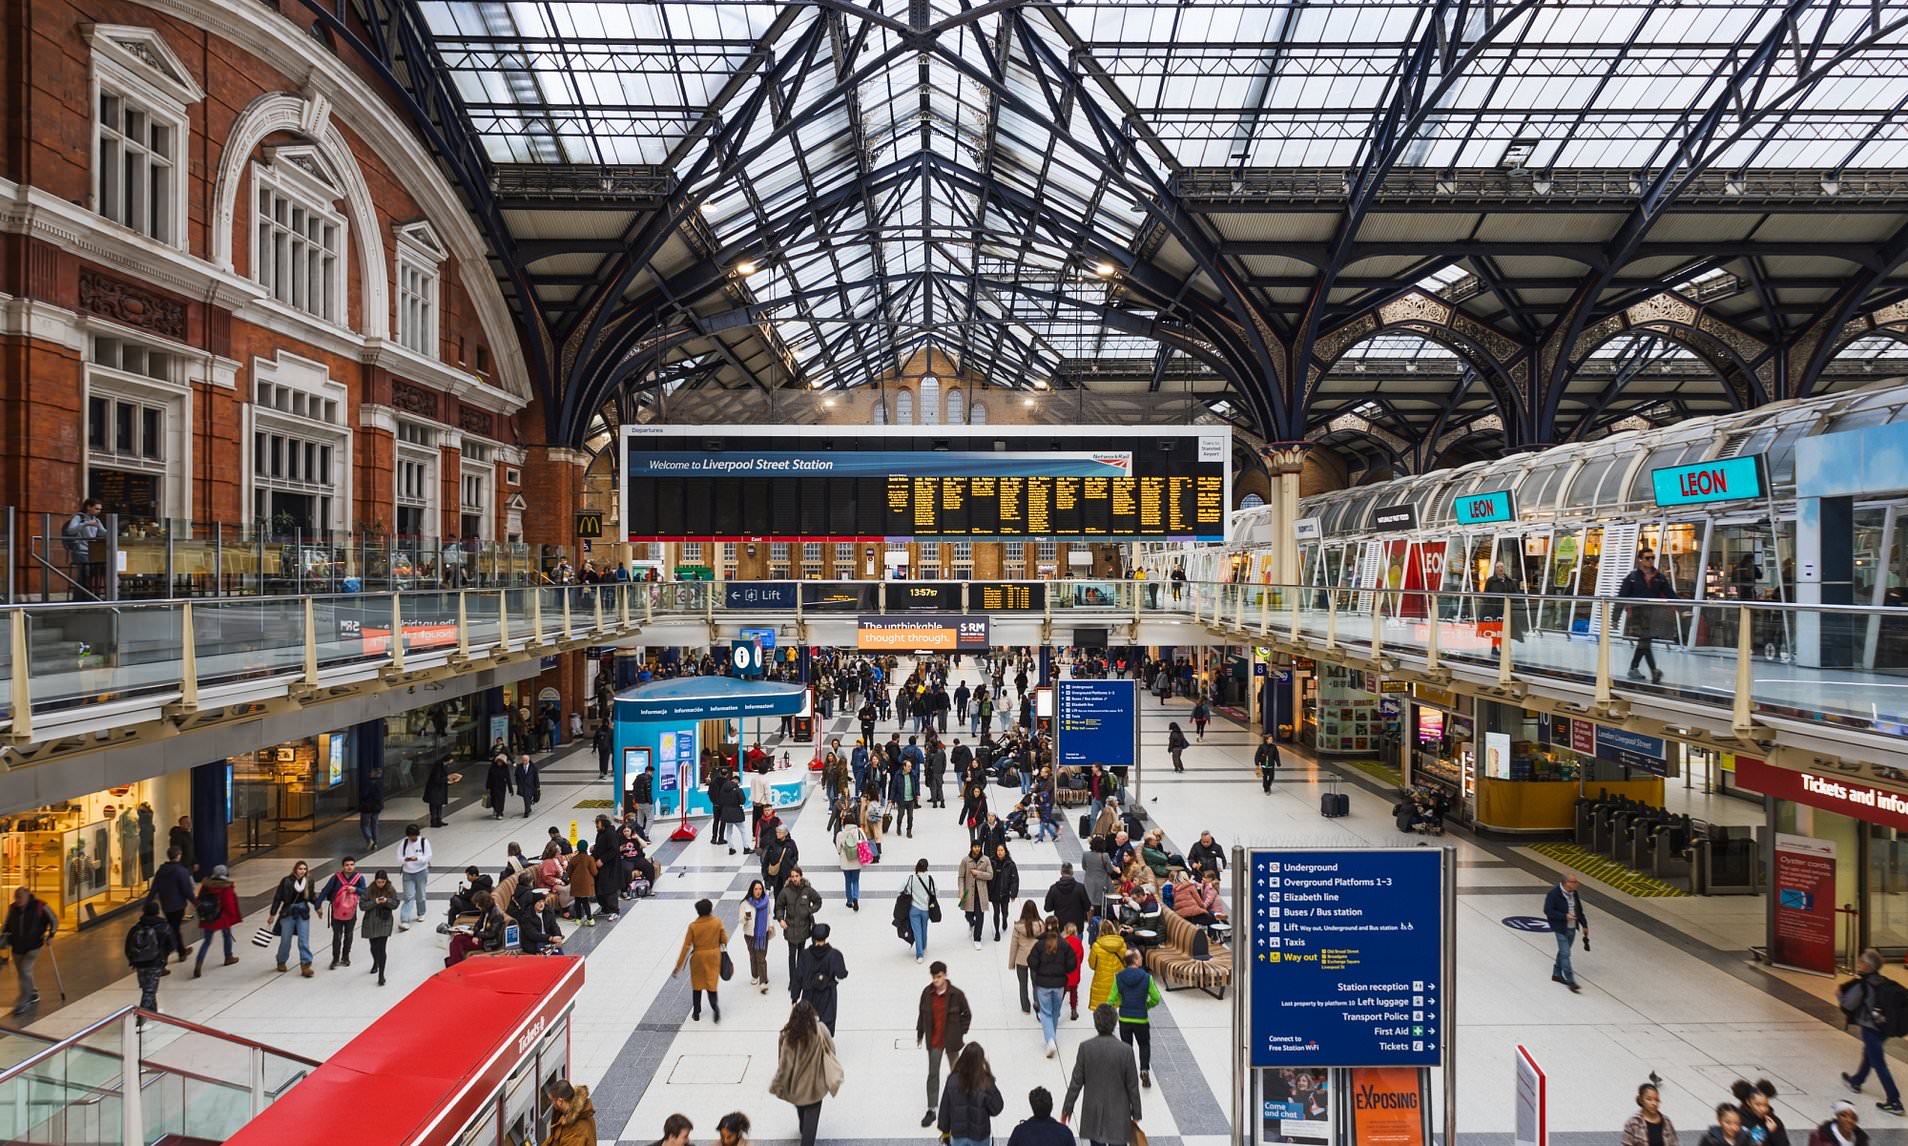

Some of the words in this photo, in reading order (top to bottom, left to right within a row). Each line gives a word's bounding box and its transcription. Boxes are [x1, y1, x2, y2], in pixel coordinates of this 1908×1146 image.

[649, 460, 690, 470] Welcome
[692, 461, 701, 470] to
[702, 459, 754, 472] Liverpool
[755, 459, 789, 471] Street
[792, 459, 833, 471] Station
[1679, 468, 1728, 497] LEON
[1469, 499, 1494, 518] LEON
[762, 589, 781, 600] Lift
[865, 632, 905, 645] thought
[1257, 665, 1263, 674] 8
[1539, 711, 1549, 726] 10
[1801, 773, 1847, 800] Tickets
[1848, 788, 1875, 806] and
[1877, 791, 1908, 815] info
[1780, 856, 1806, 865] Oyster
[1284, 863, 1338, 873] Underground
[1284, 878, 1333, 888] Overground
[1334, 878, 1374, 886] Platforms
[1284, 893, 1322, 901] Elizabeth
[1324, 893, 1339, 901] line
[1284, 908, 1309, 916] Buses
[1316, 908, 1332, 916] Bus
[1334, 908, 1363, 916] station
[1284, 923, 1299, 931] Lift
[1284, 938, 1306, 946] Taxis
[1284, 953, 1301, 963] Way
[1303, 953, 1318, 961] out
[1337, 982, 1368, 991] Station
[1369, 983, 1409, 993] reception
[1357, 998, 1375, 1006] Left
[1376, 998, 1409, 1008] luggage
[1342, 1013, 1383, 1022] Transport
[1374, 1027, 1393, 1035] First
[1394, 1027, 1409, 1035] Aid
[518, 1022, 540, 1054] Tickets
[1379, 1042, 1409, 1050] Tickets
[1356, 1084, 1418, 1110] EXPOSING
[1264, 1101, 1286, 1111] Come
[1264, 1110, 1279, 1118] and
[1280, 1110, 1298, 1119] chat
